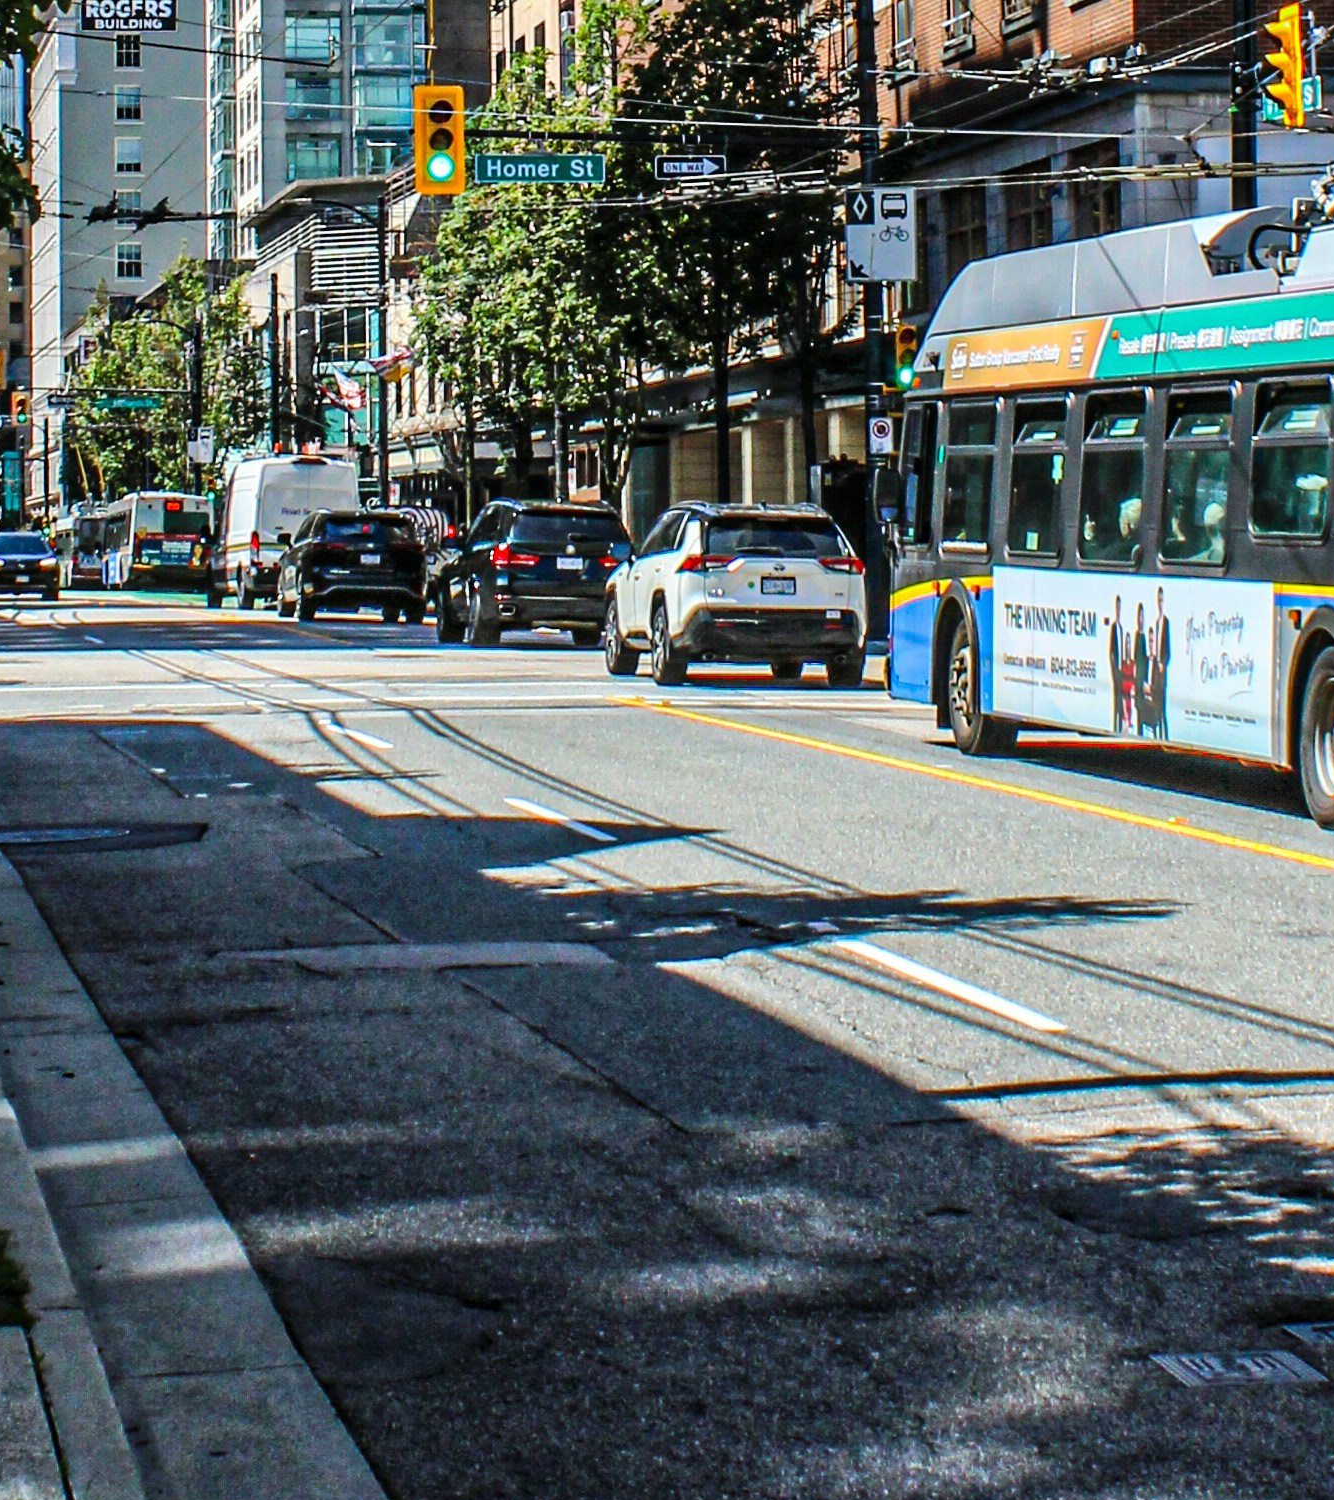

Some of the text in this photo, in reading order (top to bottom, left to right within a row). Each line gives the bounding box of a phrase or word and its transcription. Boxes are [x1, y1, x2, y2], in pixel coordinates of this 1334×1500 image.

[94, 18, 163, 30] BUILDING
[487, 159, 594, 177] Homer St
[664, 163, 683, 172] ONE
[1004, 603, 1097, 637] THE WINNING TEAM
